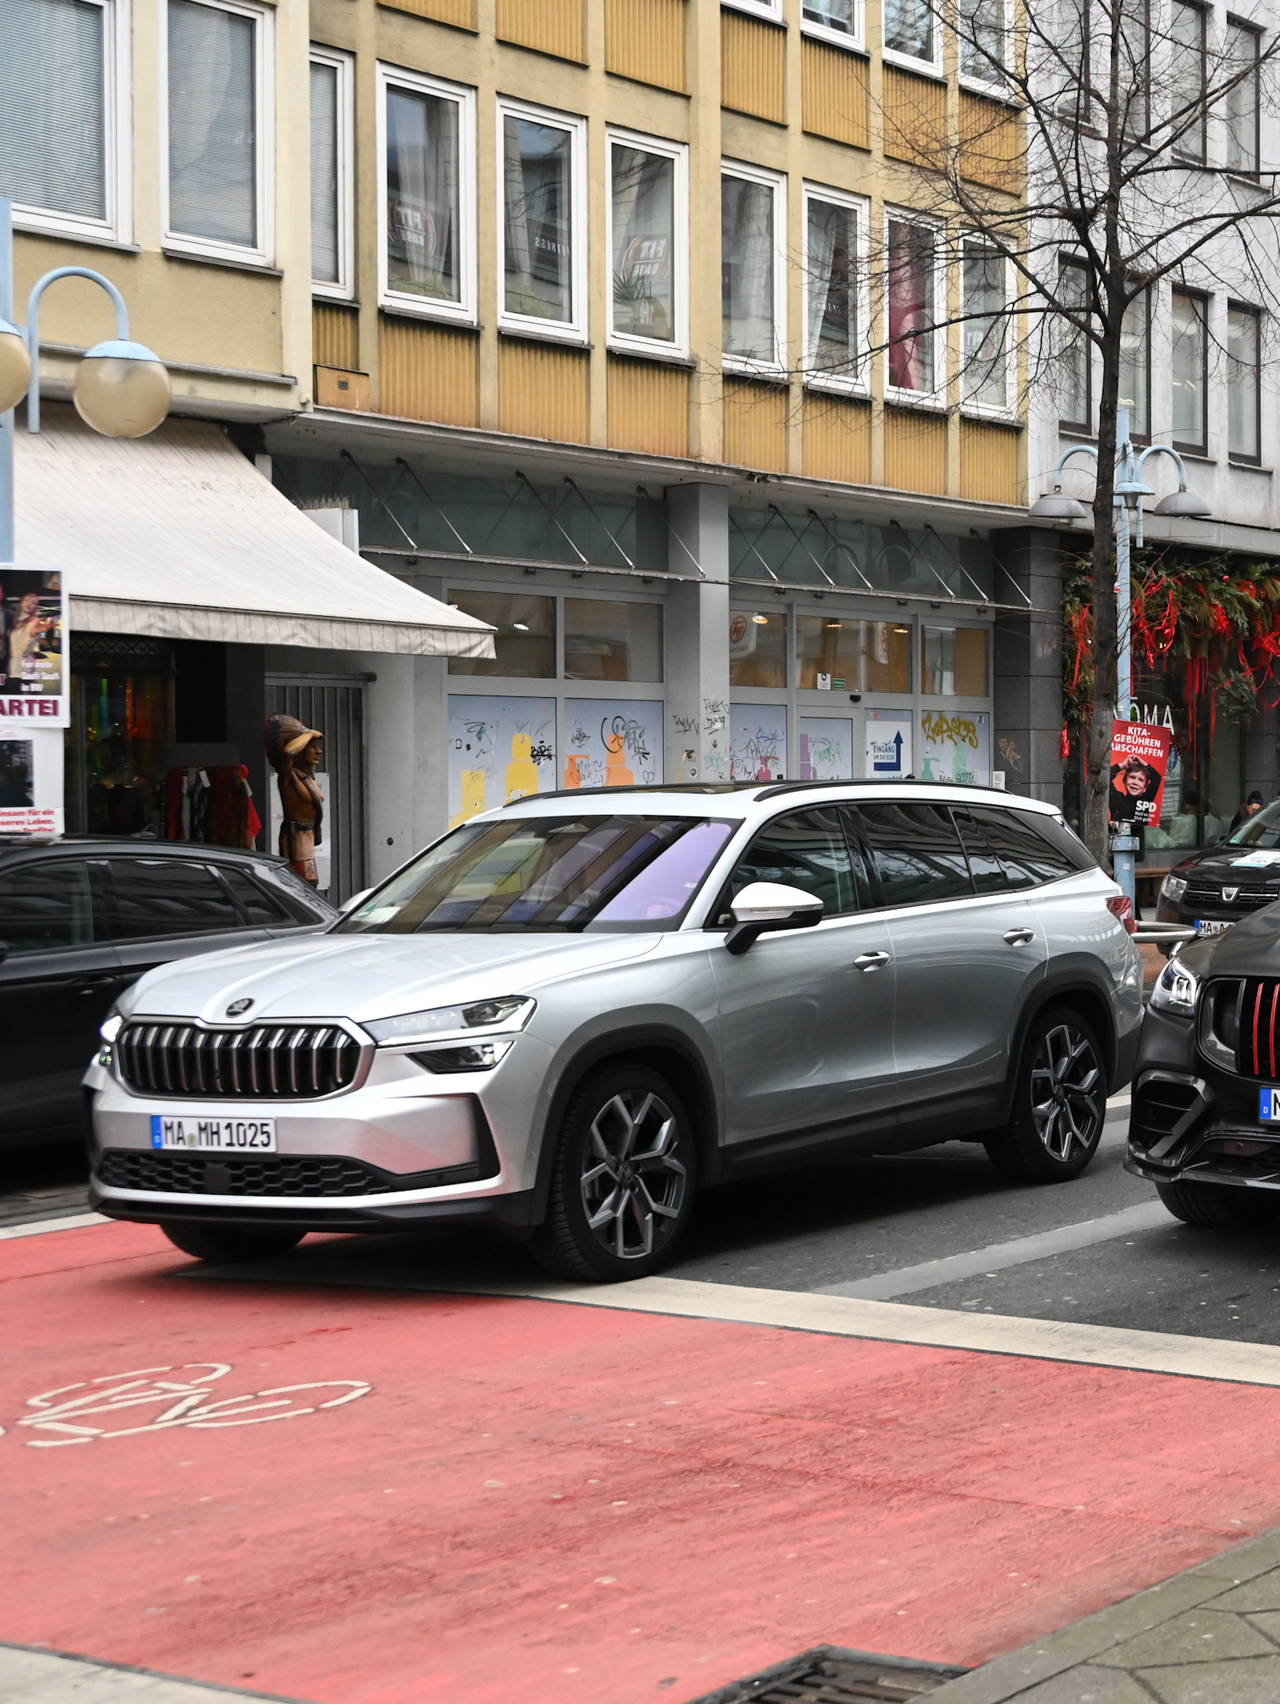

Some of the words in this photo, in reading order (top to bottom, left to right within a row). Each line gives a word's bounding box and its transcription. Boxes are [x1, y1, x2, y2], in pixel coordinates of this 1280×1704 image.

[1127, 726, 1151, 737] KITA-
[1113, 733, 1161, 748] GEBÜHREN
[873, 743, 895, 753] EINGANG
[1135, 800, 1157, 812] SPD
[1200, 922, 1213, 934] MA
[164, 1120, 186, 1146] MA
[198, 1121, 221, 1147] MH
[225, 1122, 271, 1148] 1025
